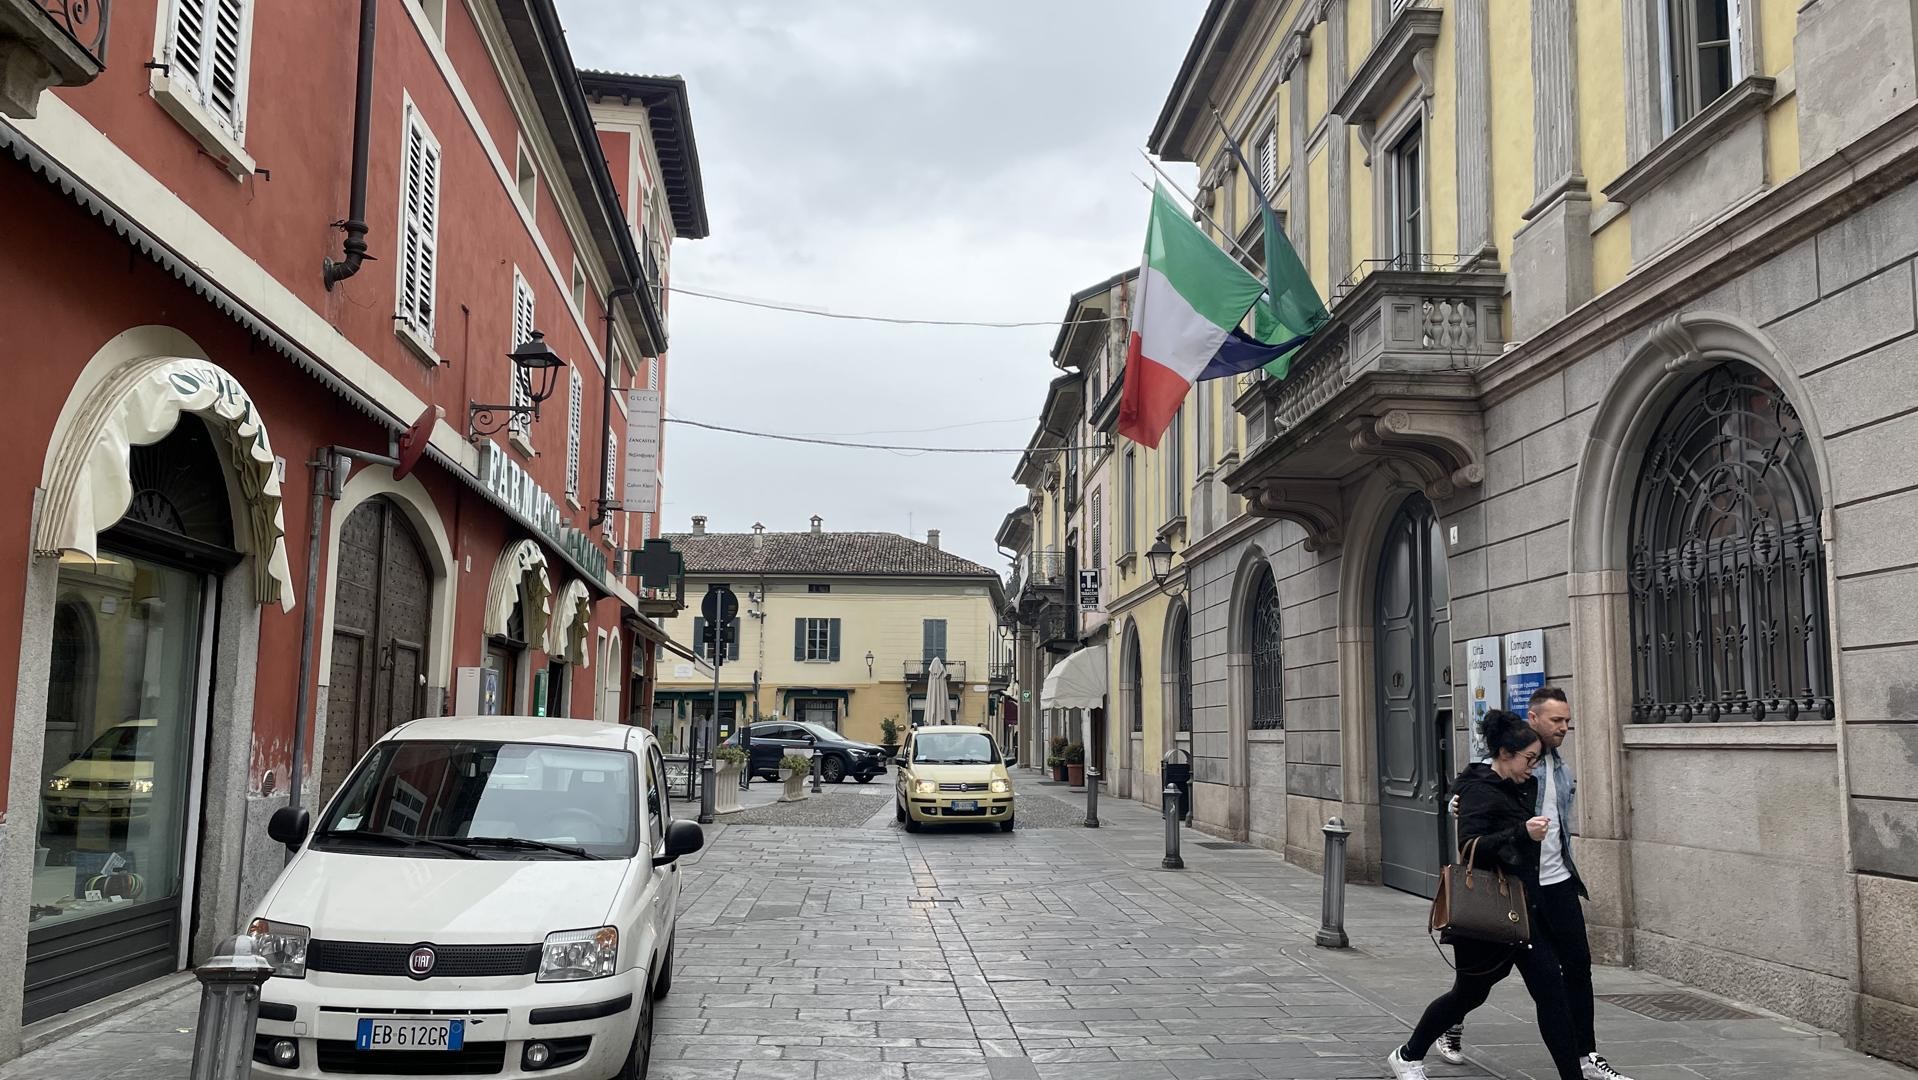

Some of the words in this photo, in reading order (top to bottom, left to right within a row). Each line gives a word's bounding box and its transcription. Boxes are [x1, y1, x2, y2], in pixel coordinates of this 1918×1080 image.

[278, 461, 283, 476] 7
[487, 437, 560, 543] FARMACIA
[1081, 571, 1096, 589] T
[1510, 640, 1532, 651] Comune
[1512, 654, 1537, 667] Codogno
[414, 955, 431, 968] FIAT
[372, 1024, 393, 1045] EB
[397, 1026, 449, 1046] 612GR
